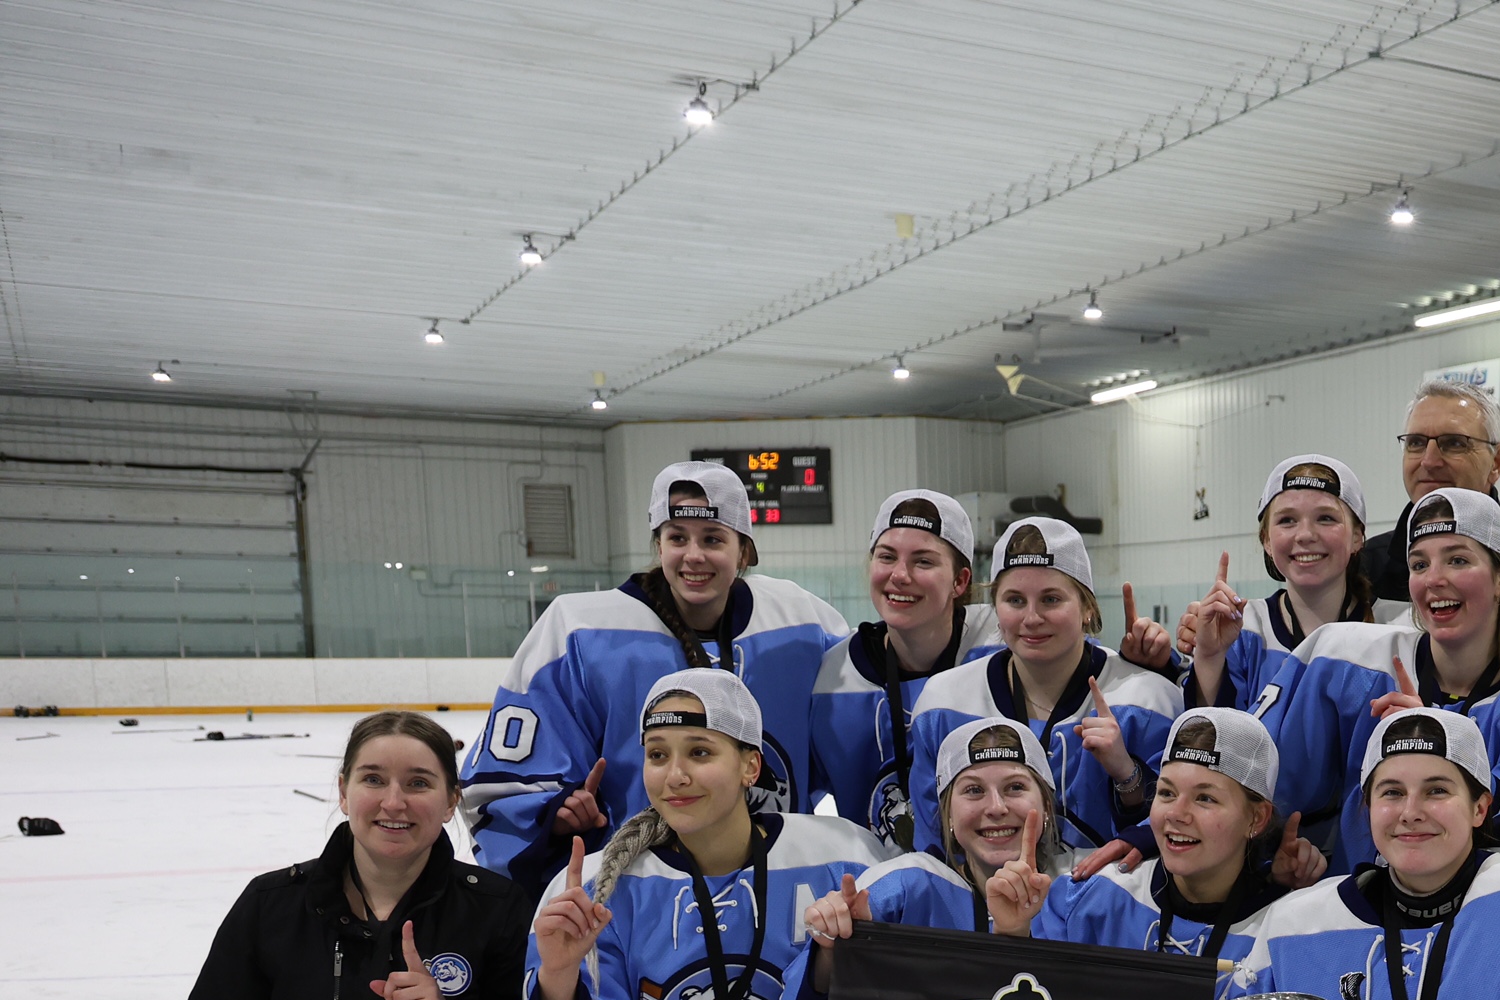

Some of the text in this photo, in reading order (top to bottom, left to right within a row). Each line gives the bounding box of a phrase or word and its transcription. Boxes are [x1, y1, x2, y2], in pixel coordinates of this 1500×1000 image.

[792, 456, 817, 467] GUEST
[804, 468, 816, 485] 0
[1287, 479, 1326, 489] CHAMPIONS
[674, 510, 715, 518] CHAMPIONS
[893, 517, 933, 529] CHAMPIONS
[1413, 524, 1453, 537] CHAMPIONS
[645, 716, 683, 726] CHAMPIONS
[1386, 742, 1434, 753] CHAMPIONS
[975, 751, 1019, 760] CHAMPIONS
[1174, 751, 1217, 764] CHAMPIONS
